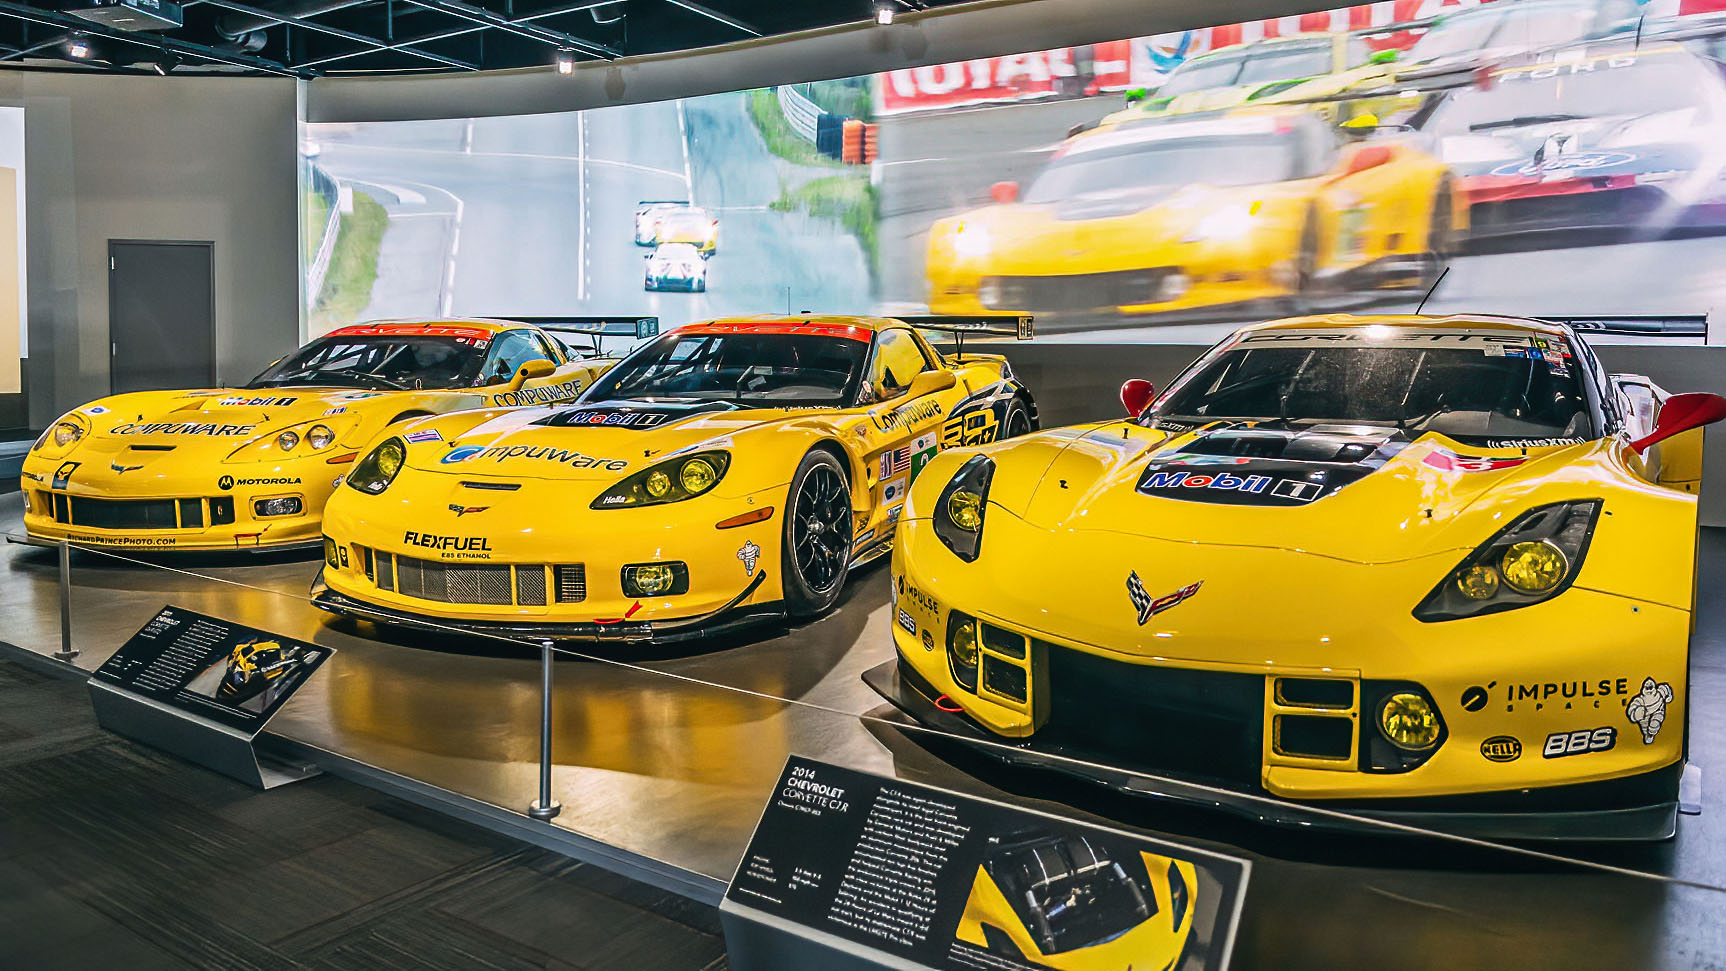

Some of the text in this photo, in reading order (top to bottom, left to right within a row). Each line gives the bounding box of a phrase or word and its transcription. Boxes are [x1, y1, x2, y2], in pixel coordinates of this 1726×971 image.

[1241, 334, 1524, 344] CORTTE
[567, 412, 640, 425] Mobil
[871, 399, 942, 433] Compuware
[109, 422, 257, 436] COMPUWARE
[1141, 471, 1272, 494] Mobil
[404, 531, 492, 551] FLEXFUEL
[1508, 678, 1628, 701] IMPULSE
[1483, 742, 1520, 756] HELLA
[1544, 728, 1613, 757] BBS
[792, 766, 816, 779] 2014
[782, 787, 828, 808] CORVETTE
[787, 777, 845, 799] CHEVROLET
